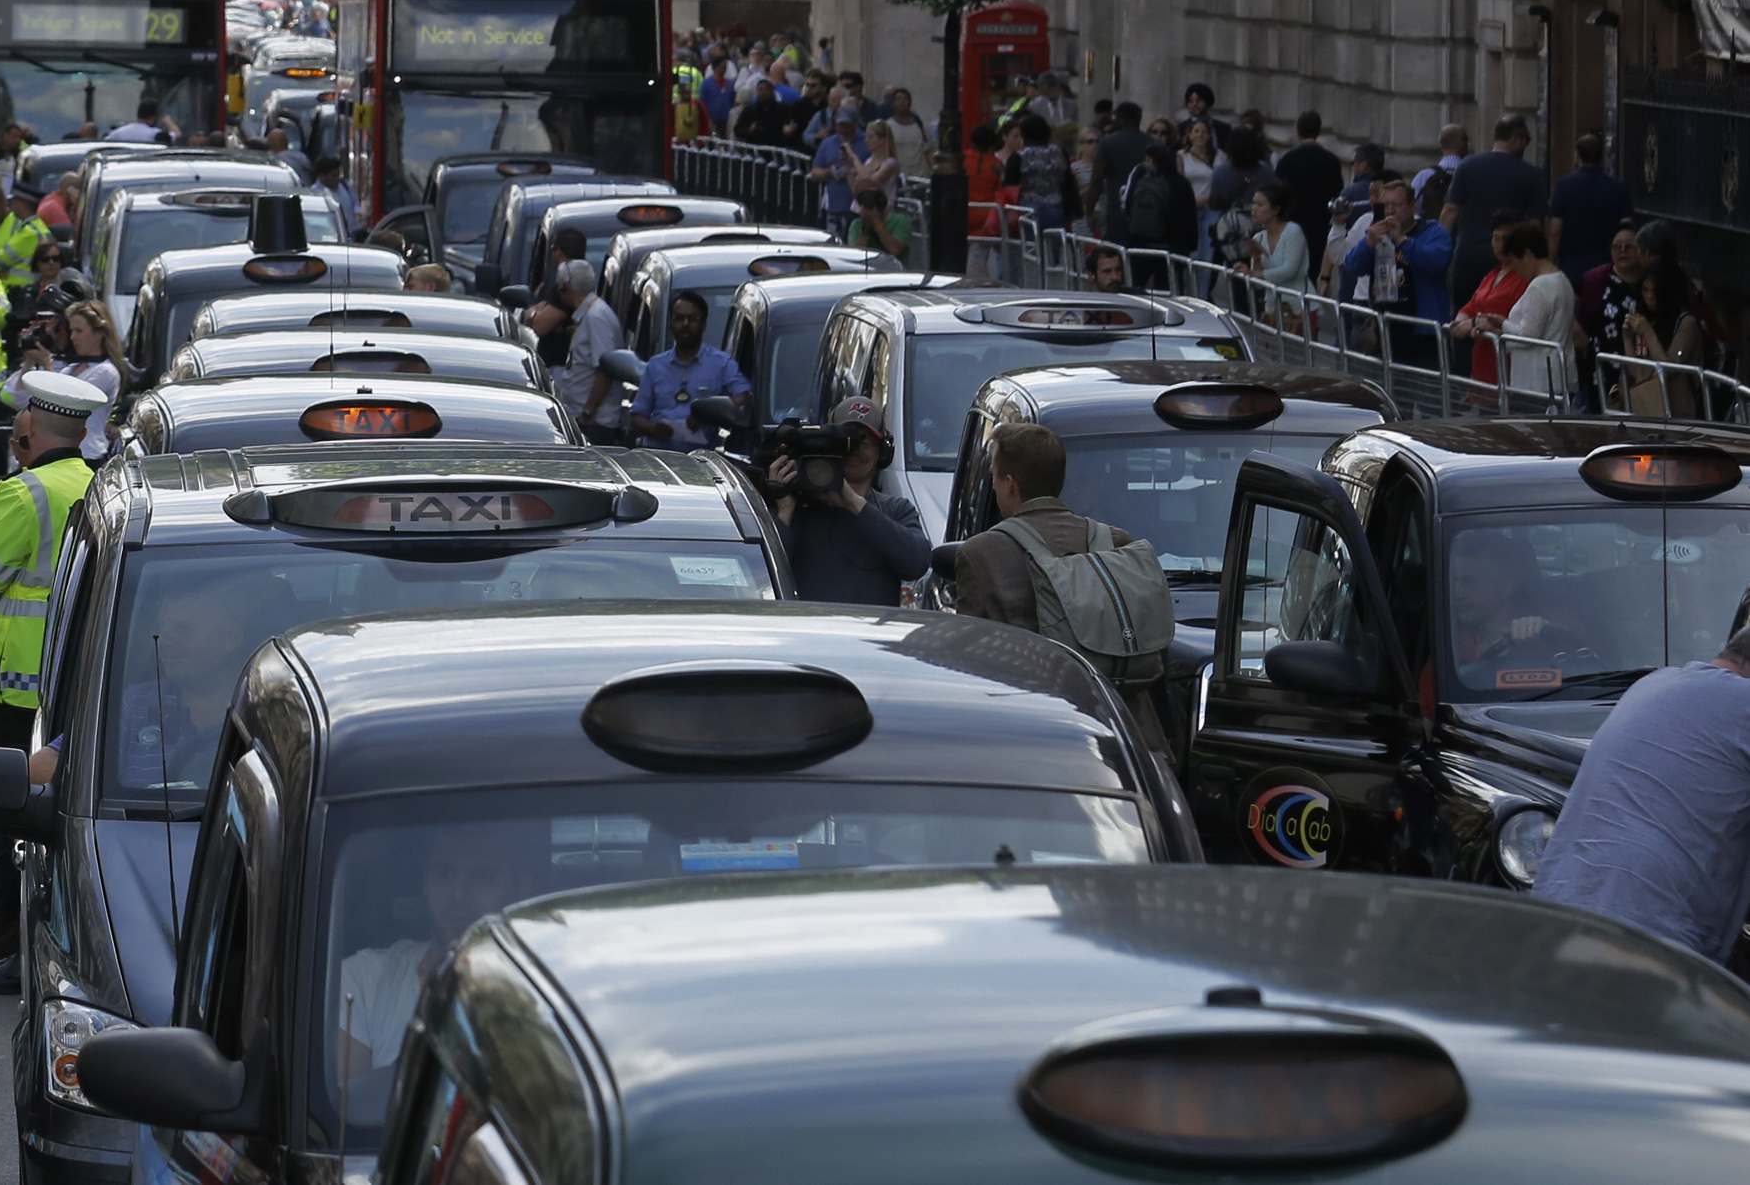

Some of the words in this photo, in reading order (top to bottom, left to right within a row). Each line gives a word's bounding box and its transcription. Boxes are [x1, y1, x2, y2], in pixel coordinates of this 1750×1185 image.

[420, 25, 456, 45] Not
[461, 26, 477, 45] in
[482, 25, 546, 45] Service
[334, 409, 410, 432] TAXI
[378, 495, 512, 522] TAXI
